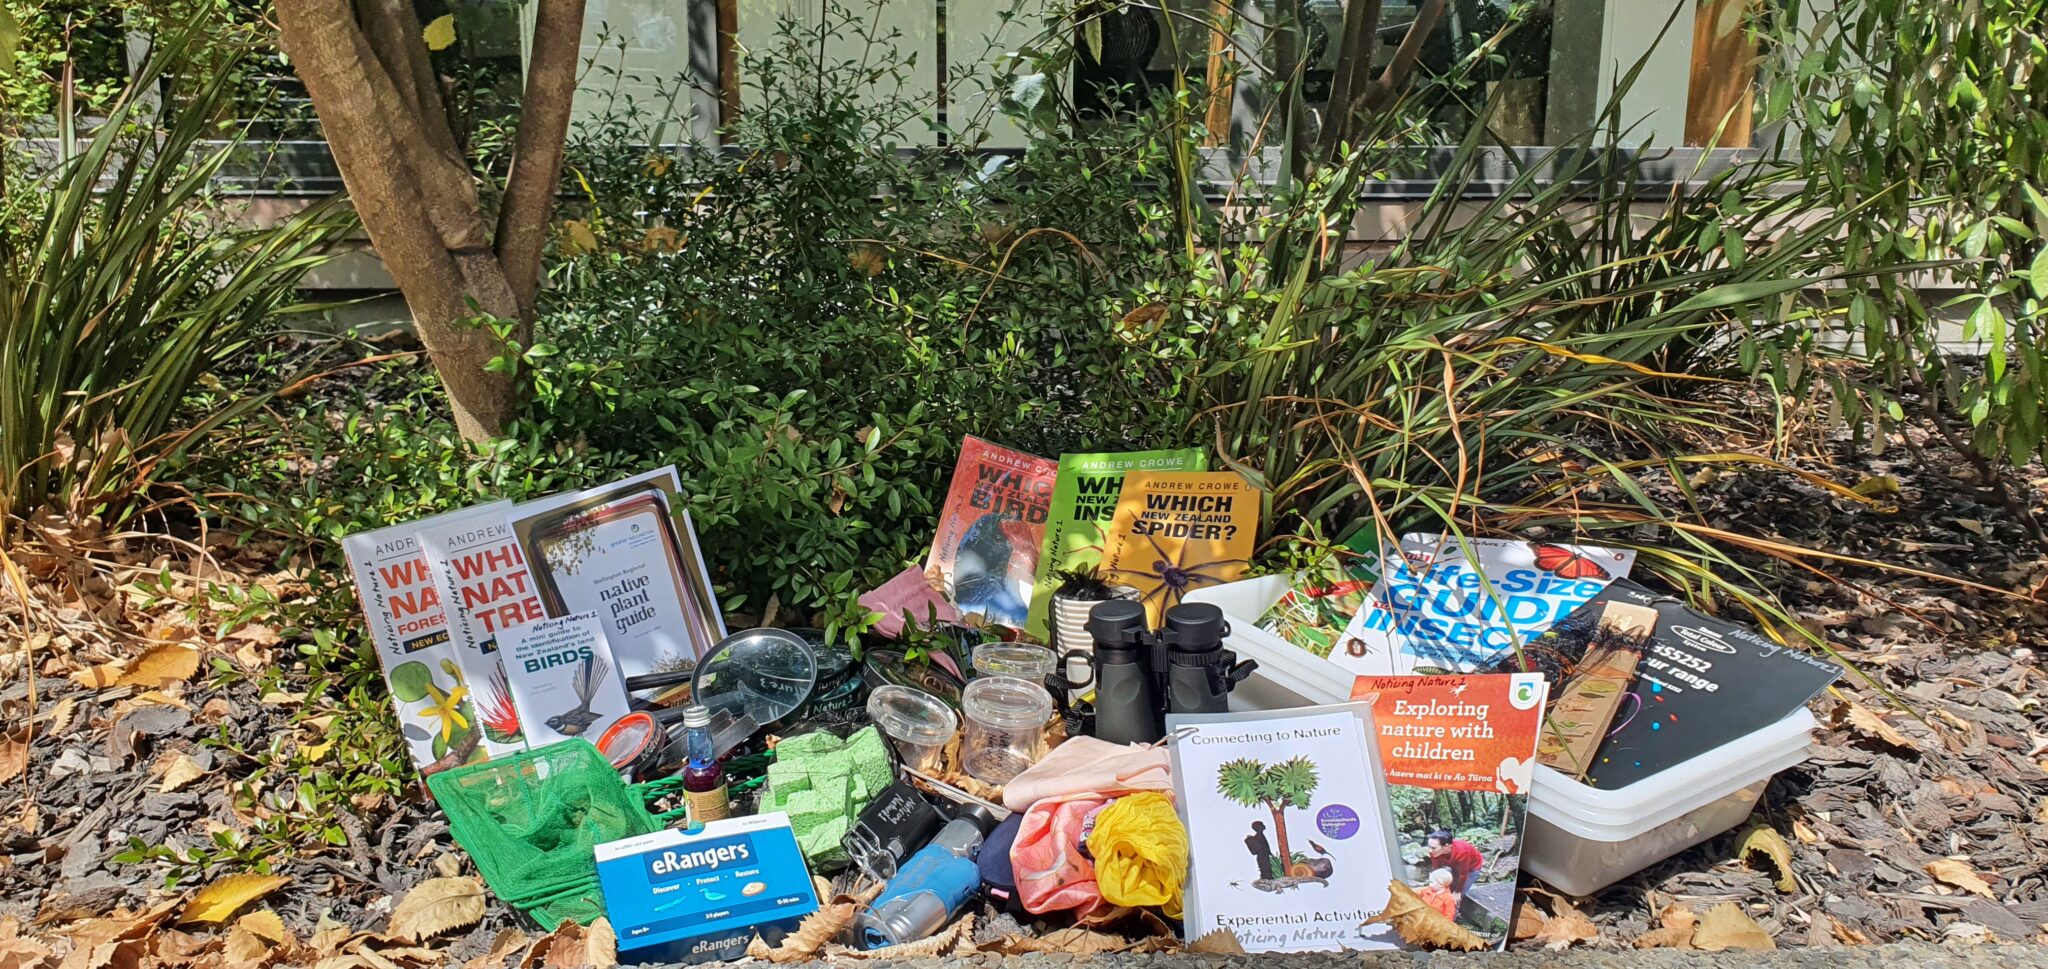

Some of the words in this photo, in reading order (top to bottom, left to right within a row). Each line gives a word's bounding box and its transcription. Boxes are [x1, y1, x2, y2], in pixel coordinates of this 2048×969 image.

[982, 450, 1031, 470] ANDREW
[1082, 460, 1133, 470] ANDREW
[1139, 457, 1184, 467] CROWE
[978, 463, 1052, 498] WHIC
[1076, 476, 1124, 495] WH
[1144, 481, 1194, 491] ANDREW
[1199, 482, 1240, 490] CROWE
[969, 487, 1049, 525] BIRD
[1075, 496, 1108, 504] NEW
[1146, 493, 1233, 513] WHICH
[1073, 505, 1115, 522] INS
[1140, 511, 1170, 520] NEW
[1174, 512, 1231, 523] ZEALAND
[448, 523, 507, 549] ANDREW
[1050, 527, 1063, 557] Nature
[1131, 520, 1237, 541] SPIDER?
[451, 542, 524, 581] WHI
[1110, 542, 1124, 570] Nature
[592, 571, 622, 585] Wellington
[622, 562, 646, 575] Regional
[1394, 561, 1604, 599] Life-Size
[368, 570, 386, 609] Nature
[445, 570, 462, 605] Nature
[461, 569, 528, 610] NAT
[600, 575, 650, 602] native
[475, 595, 544, 634] TRE
[610, 588, 650, 618] plant
[457, 605, 478, 650] Noticing
[615, 605, 656, 635] guide
[382, 610, 402, 656] Noticing
[411, 635, 434, 650] NEW
[516, 645, 529, 653] the
[530, 633, 580, 649] identification
[529, 633, 546, 642] mini
[548, 629, 571, 638] guide
[1680, 628, 1701, 641] Total
[1700, 637, 1728, 651] Colour
[1728, 629, 1782, 657] Noticing
[515, 651, 534, 660] New
[577, 637, 595, 645] land
[524, 645, 594, 673] BIRDS
[1371, 679, 1415, 694] Noticing
[1417, 678, 1457, 688] Nature
[1668, 667, 1720, 693] range
[1393, 700, 1489, 720] Exploring
[1191, 732, 1272, 746] Connecting
[1276, 731, 1290, 741] to
[1294, 726, 1341, 739] Nature
[1381, 724, 1446, 739] nature
[1449, 723, 1494, 739] with
[1392, 744, 1475, 761] children
[1390, 769, 1414, 778] haere
[1416, 771, 1432, 780] mai
[1433, 772, 1442, 780] ki
[652, 843, 749, 875] eRangers
[653, 883, 680, 894] Discover
[696, 875, 720, 886] Protect
[735, 868, 759, 878] Restore
[1216, 912, 1308, 928] Experiential
[692, 934, 749, 954] eRangers
[1292, 927, 1346, 942] Nature
